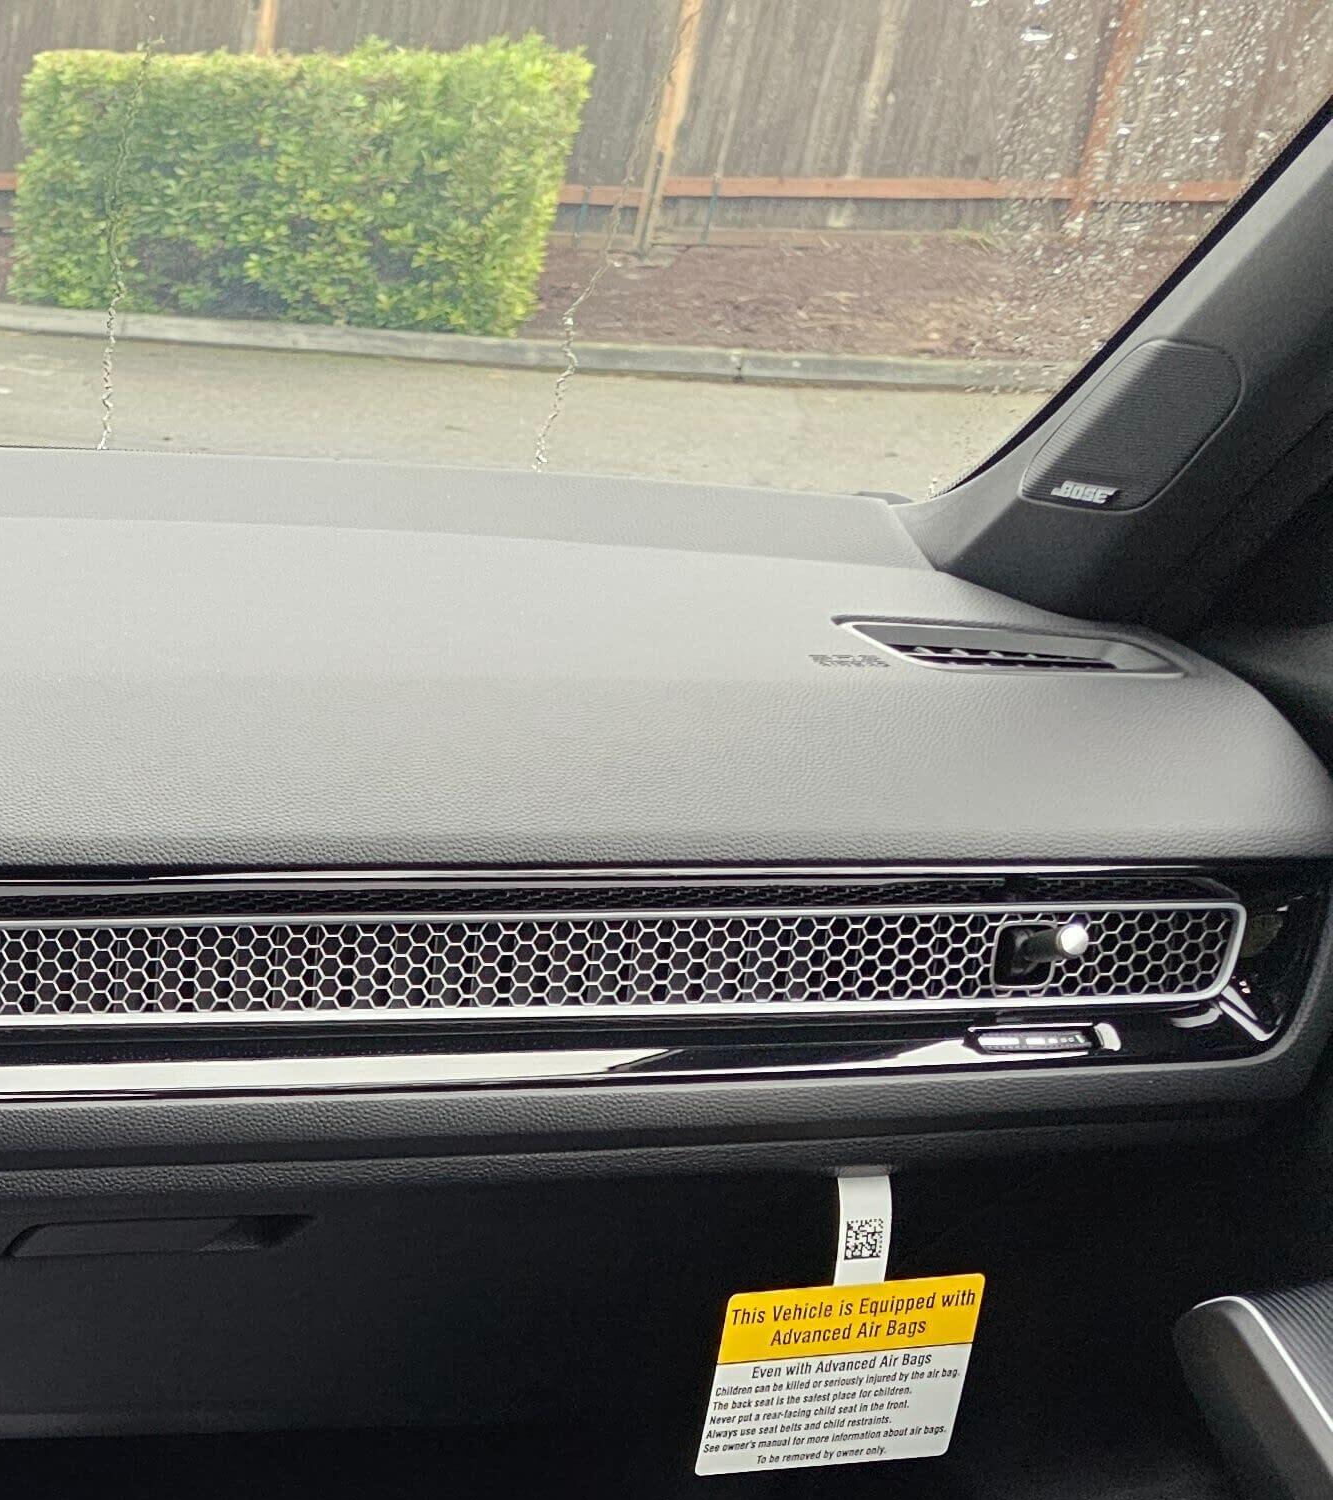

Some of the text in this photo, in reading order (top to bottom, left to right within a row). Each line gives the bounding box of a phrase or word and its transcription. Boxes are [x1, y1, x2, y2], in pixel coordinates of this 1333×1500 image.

[1050, 480, 1120, 504] BOSE
[732, 1289, 977, 1325] This Vehicle is Equipped with
[770, 1319, 926, 1346] Advanced Air Bags
[752, 1353, 932, 1380] Even with Advanced Air Bags
[715, 1367, 960, 1397] Children can be killed or seriously injured by the air bag.
[713, 1385, 913, 1411] The back seat is the safest place for children.
[709, 1414, 735, 1425] Never
[737, 1412, 753, 1424] put
[762, 1408, 812, 1421] rear-facing
[813, 1405, 836, 1416] child
[837, 1404, 857, 1414] seat
[859, 1402, 868, 1412] in
[870, 1401, 885, 1411] the
[886, 1399, 910, 1410] front.
[704, 1424, 947, 1453] See owner's manual for more information about air bags.
[706, 1414, 892, 1440] Always use seat belts and child restraints.
[756, 1446, 888, 1465] To be removed by owner only.
